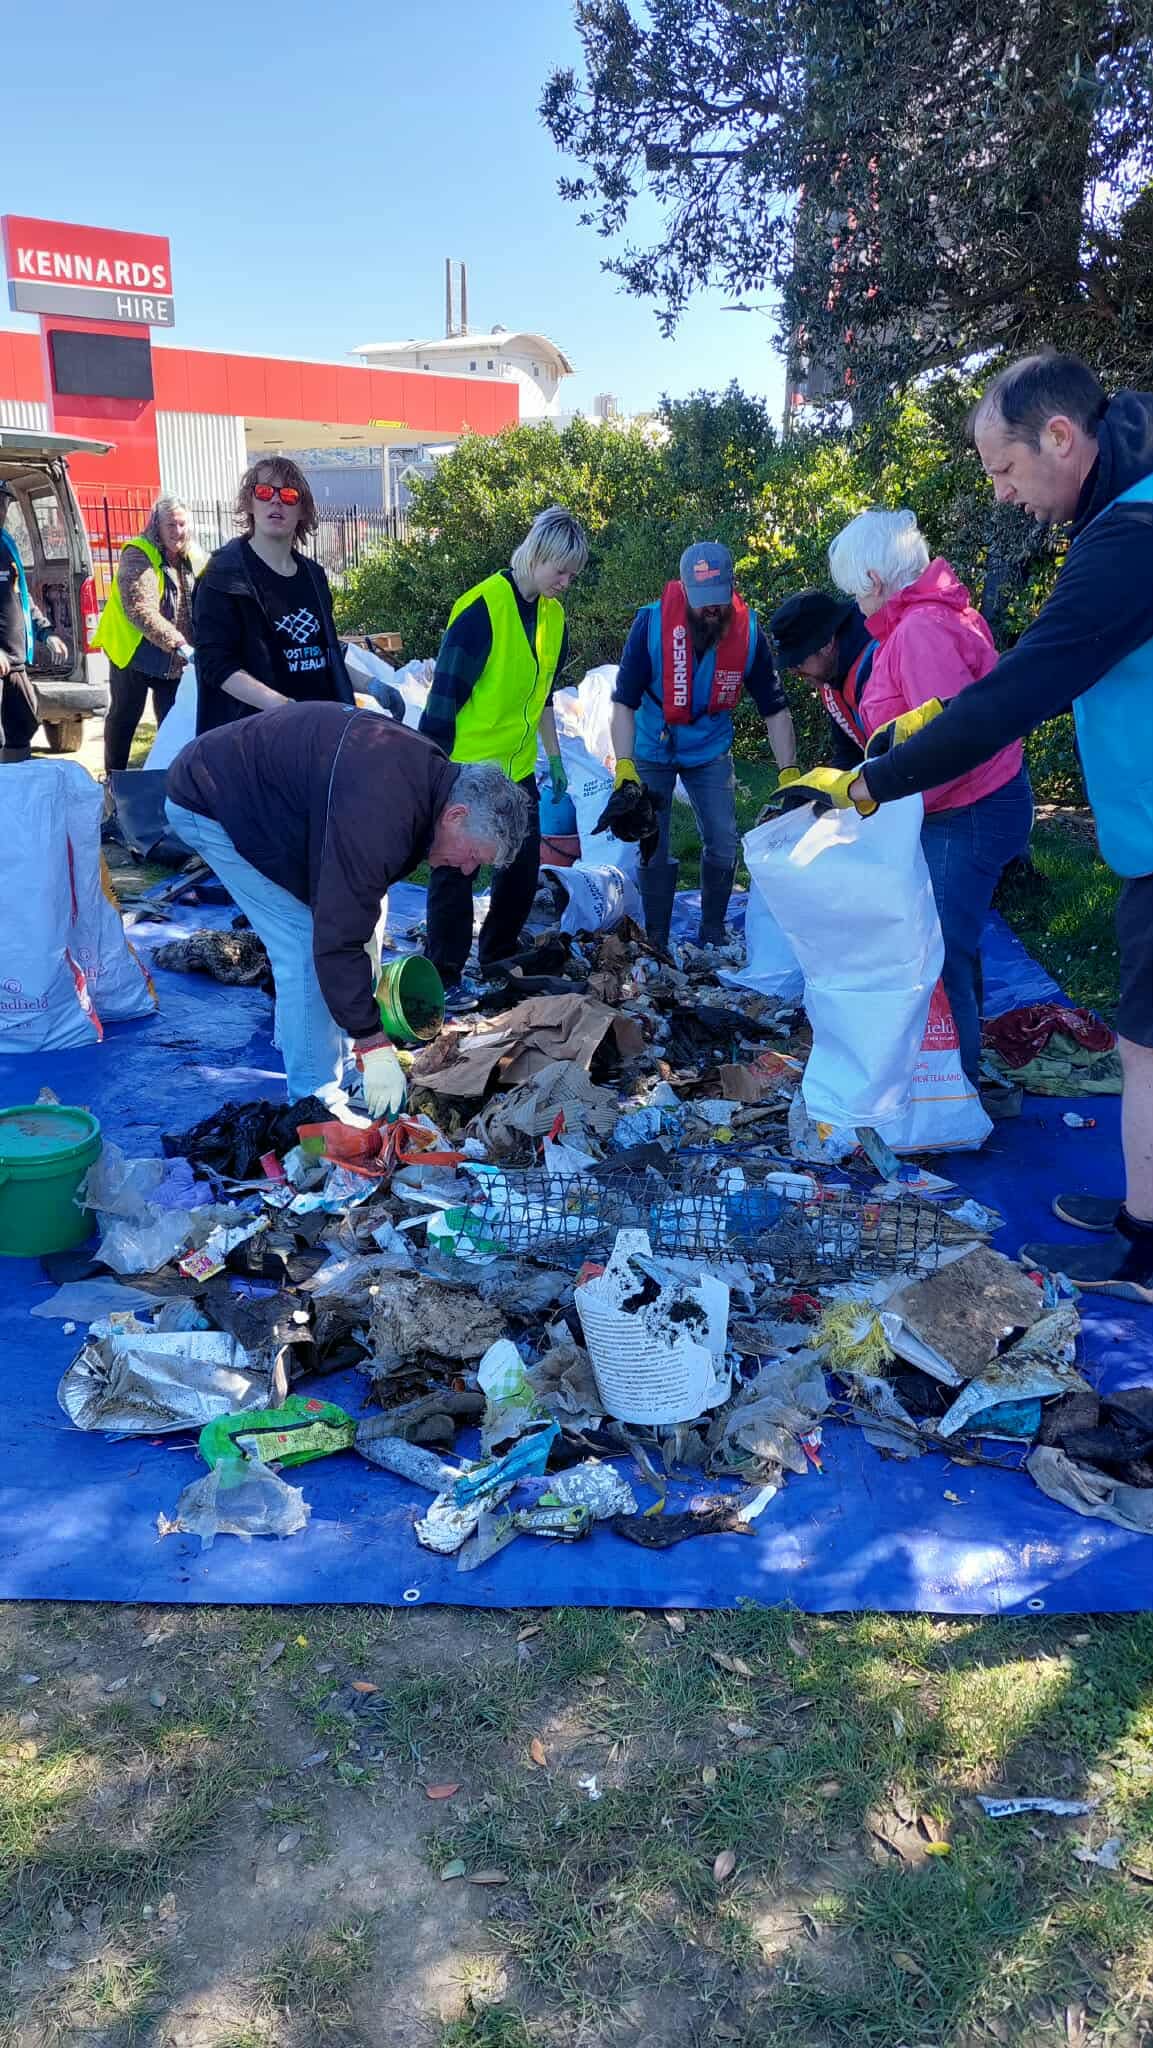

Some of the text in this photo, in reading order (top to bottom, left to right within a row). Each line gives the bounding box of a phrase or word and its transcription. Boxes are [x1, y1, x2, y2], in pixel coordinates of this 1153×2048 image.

[17, 248, 167, 288] KENNARDS
[117, 296, 169, 321] HIRE
[673, 625, 688, 706] BURNSCO
